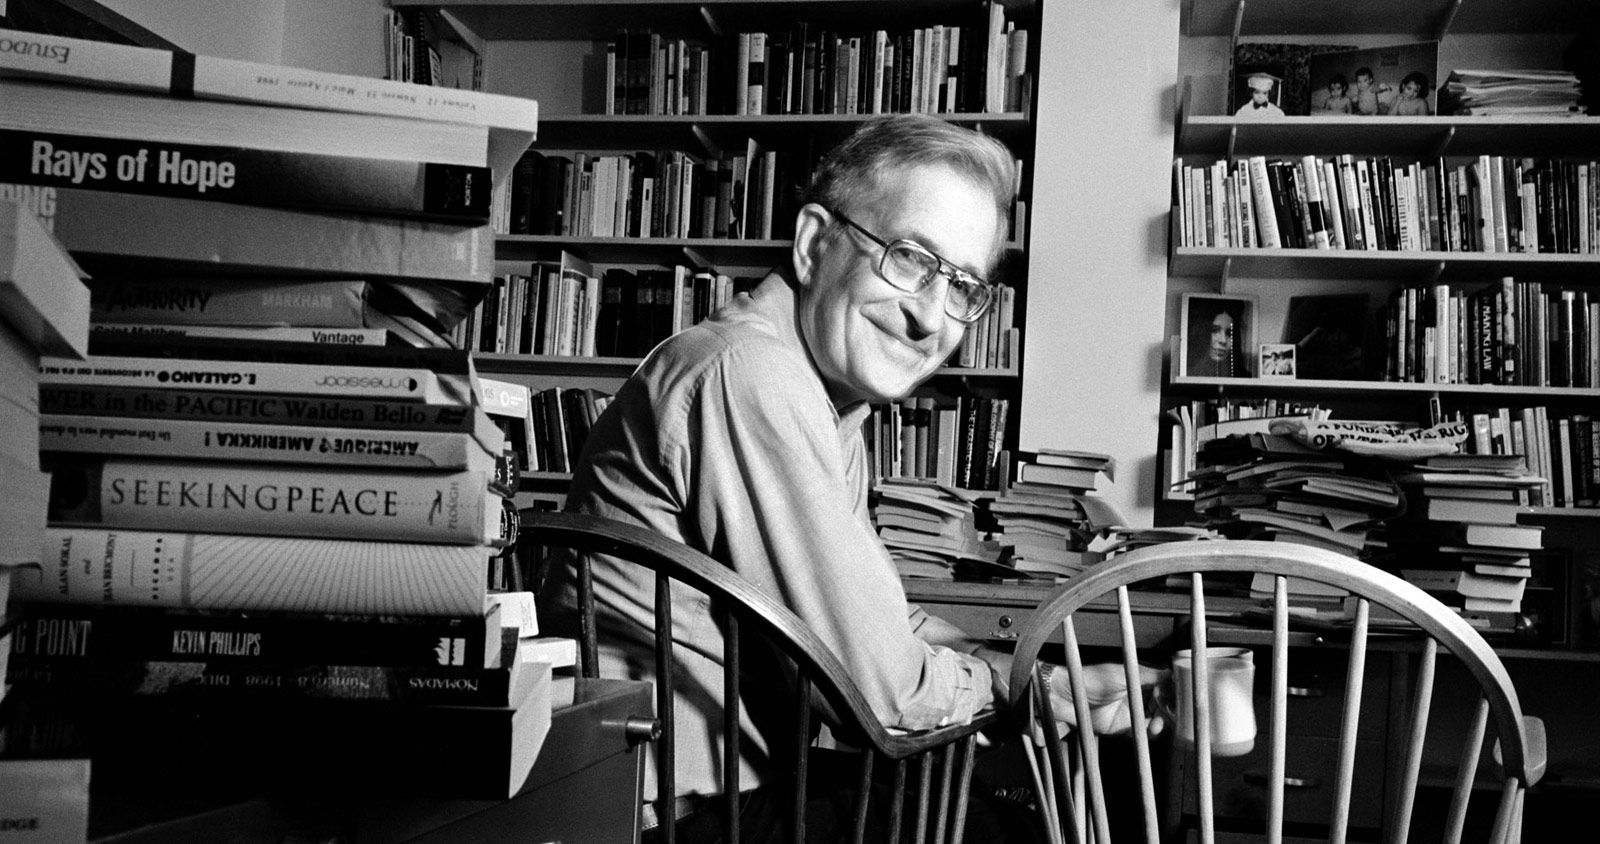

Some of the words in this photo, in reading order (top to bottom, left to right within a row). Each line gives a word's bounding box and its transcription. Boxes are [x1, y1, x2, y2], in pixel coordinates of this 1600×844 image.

[31, 140, 107, 184] Rays
[117, 147, 150, 183] of
[157, 152, 237, 193] Hope
[464, 172, 473, 207] NORTON
[262, 293, 334, 311] MARKHAM
[311, 329, 365, 345] Vantage
[1482, 305, 1492, 346] MAKING
[1483, 347, 1493, 371] LAW
[171, 370, 242, 385] GALEANO
[132, 393, 168, 413] the
[174, 396, 277, 420] PACIFIC
[283, 399, 364, 423] Walden
[372, 404, 426, 425] Bello
[217, 431, 314, 452] AMERIKKKA
[35, 618, 92, 657] POINT
[172, 629, 207, 653] KEVIN
[208, 632, 262, 657] PHILLIPS
